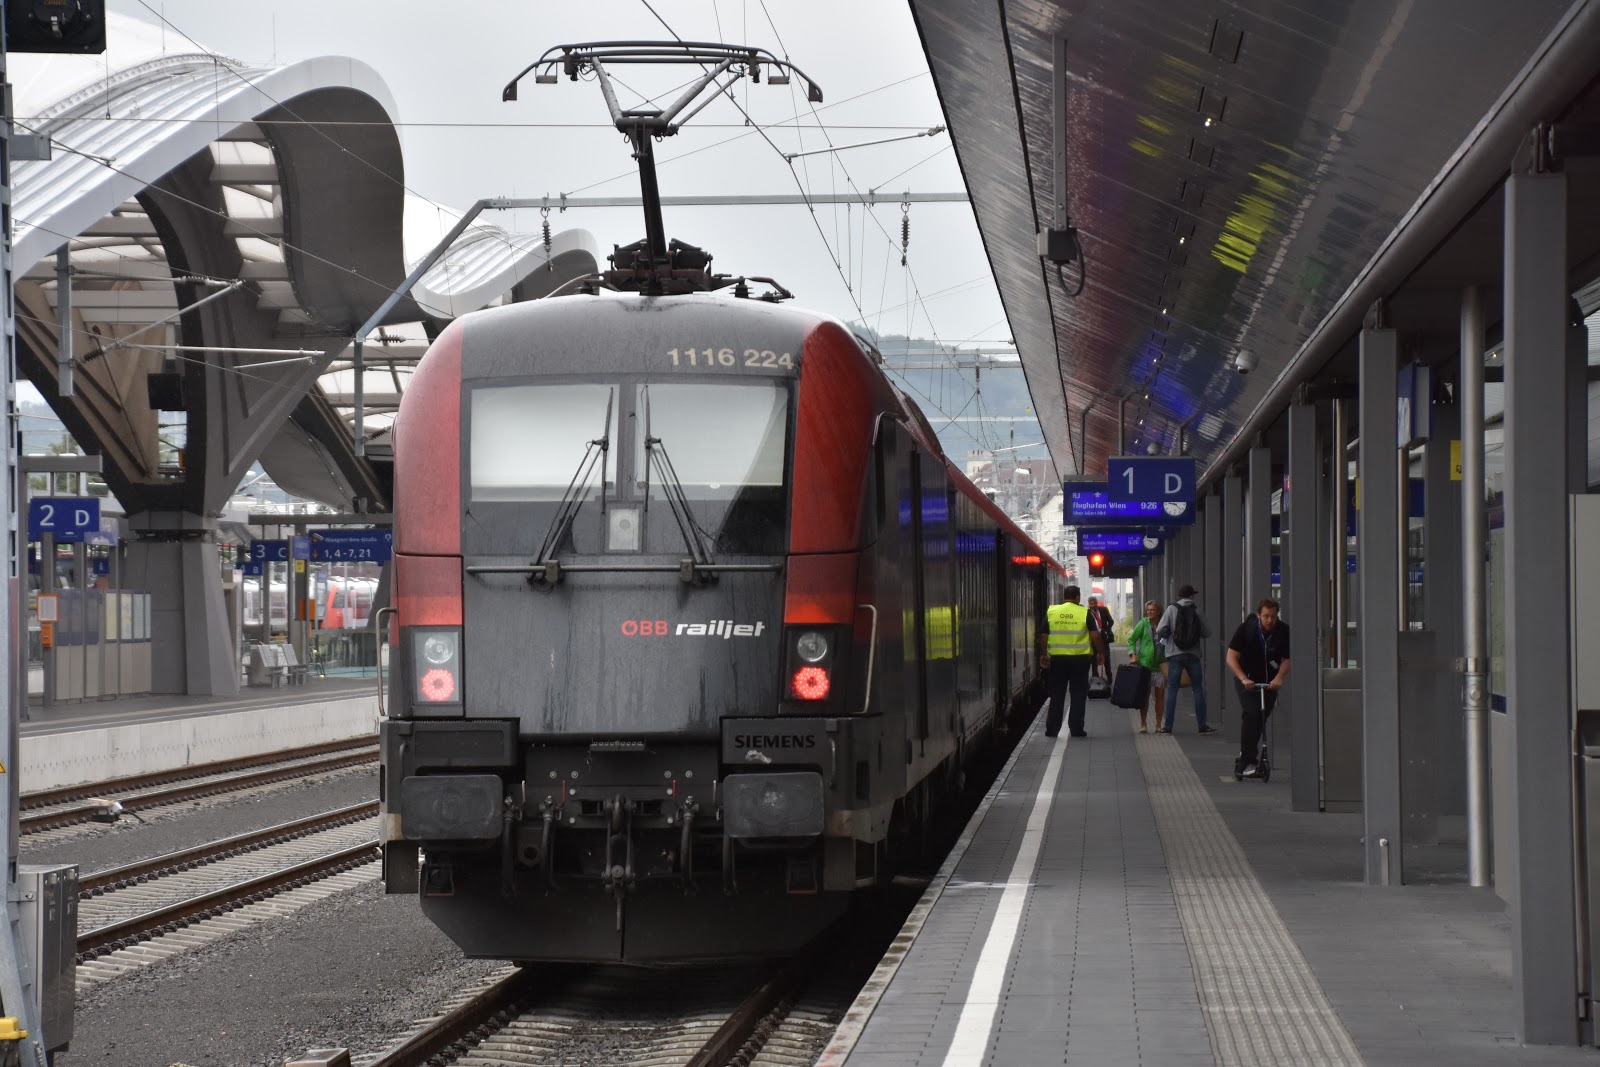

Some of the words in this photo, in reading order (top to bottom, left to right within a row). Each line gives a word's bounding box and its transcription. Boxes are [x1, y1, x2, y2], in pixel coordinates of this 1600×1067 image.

[667, 347, 735, 366] 1116
[743, 348, 794, 369] 224
[1122, 466, 1134, 494] 1
[1165, 473, 1182, 494] D
[40, 504, 54, 526] 2
[75, 509, 90, 526] D
[256, 544, 266, 558] 3
[278, 547, 286, 558] C
[253, 566, 259, 574] B
[621, 619, 669, 636] ÖBB
[675, 620, 765, 640] railjet
[734, 734, 815, 749] SIEMENS
